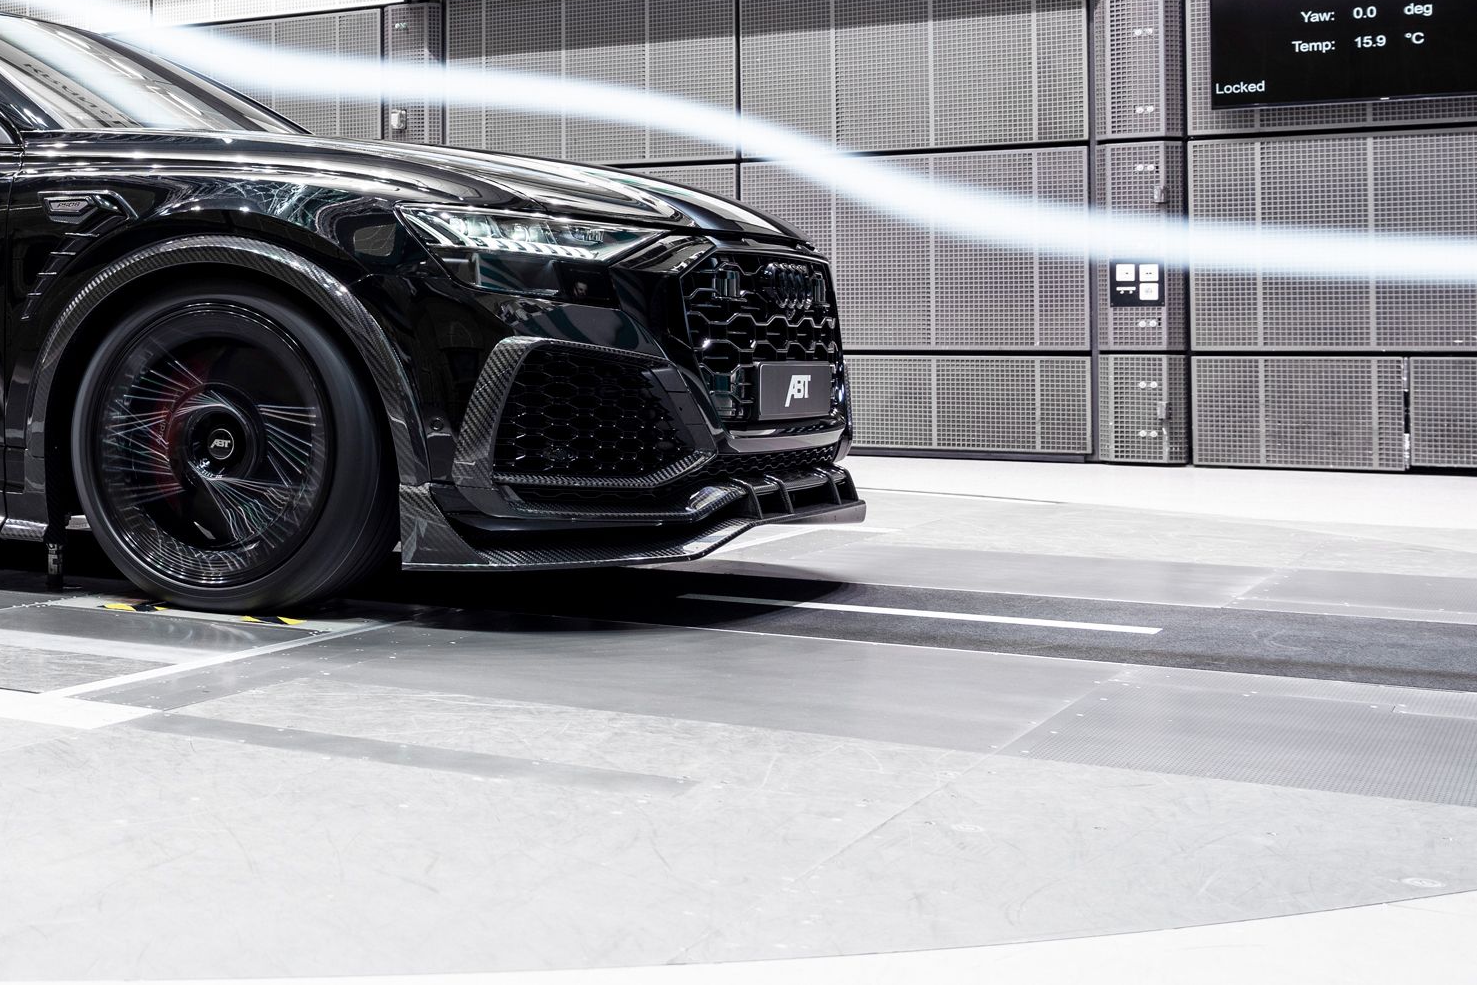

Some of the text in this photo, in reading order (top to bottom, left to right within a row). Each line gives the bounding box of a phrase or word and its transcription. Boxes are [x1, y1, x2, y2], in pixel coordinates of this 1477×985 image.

[1301, 3, 1432, 22] Yaw: 0.0 deg
[1292, 32, 1424, 53] Temp: 15.9 °C
[1216, 81, 1264, 94] Locked
[784, 374, 812, 407] ABT
[210, 438, 231, 449] ABT
